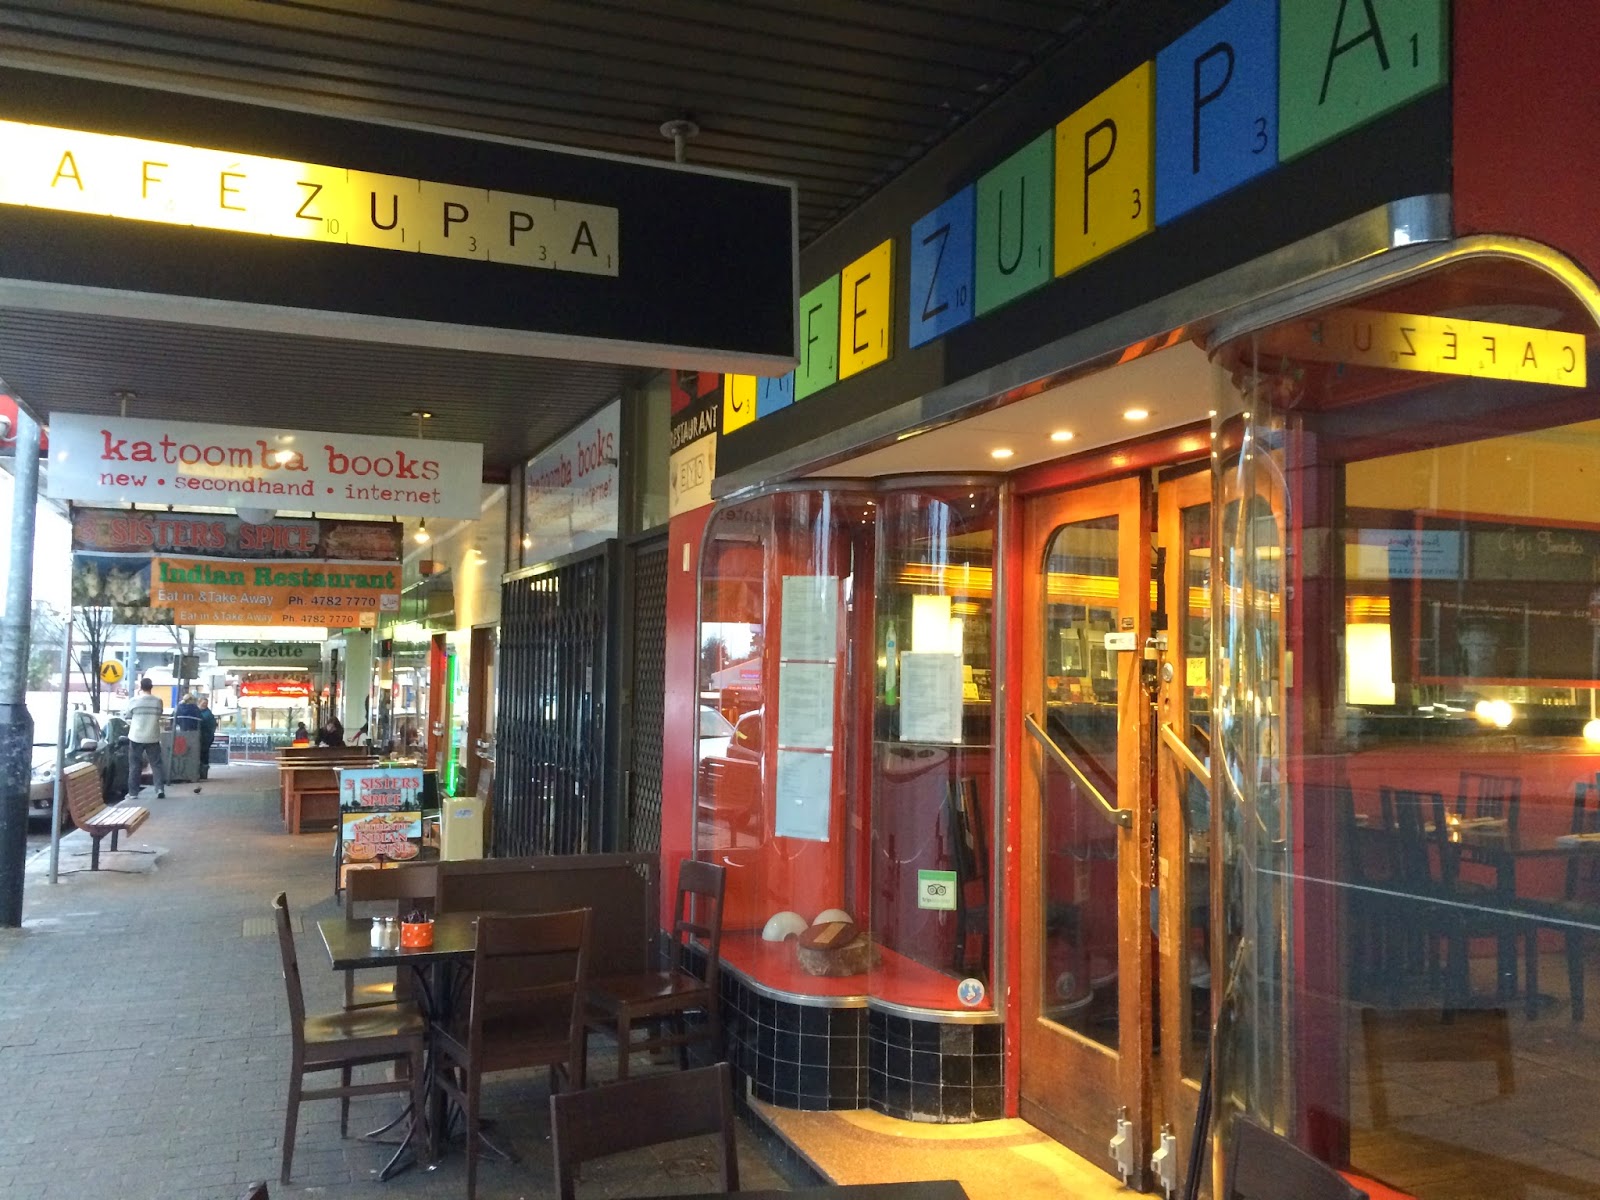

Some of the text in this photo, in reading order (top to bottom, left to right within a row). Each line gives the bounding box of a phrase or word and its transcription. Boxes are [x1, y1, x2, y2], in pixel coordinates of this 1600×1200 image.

[101, 430, 440, 481] katoomba books
[100, 471, 441, 505] new secondhand internet
[110, 517, 226, 549] SISTERS
[239, 523, 317, 552] SPICE
[158, 561, 396, 590] Indian Restaurant
[158, 589, 179, 602] Eat
[183, 592, 194, 602] in
[240, 592, 274, 606] Away
[311, 596, 342, 607] 4782
[346, 597, 376, 607] 7770
[179, 611, 198, 621] Eat
[246, 612, 273, 623] Away
[301, 614, 325, 623] 4782
[328, 615, 353, 623] 7770
[232, 644, 303, 658] Gazette
[345, 777, 420, 790] 3 SISTERS
[361, 793, 401, 806] SPICE
[353, 831, 409, 844] INDIAN
